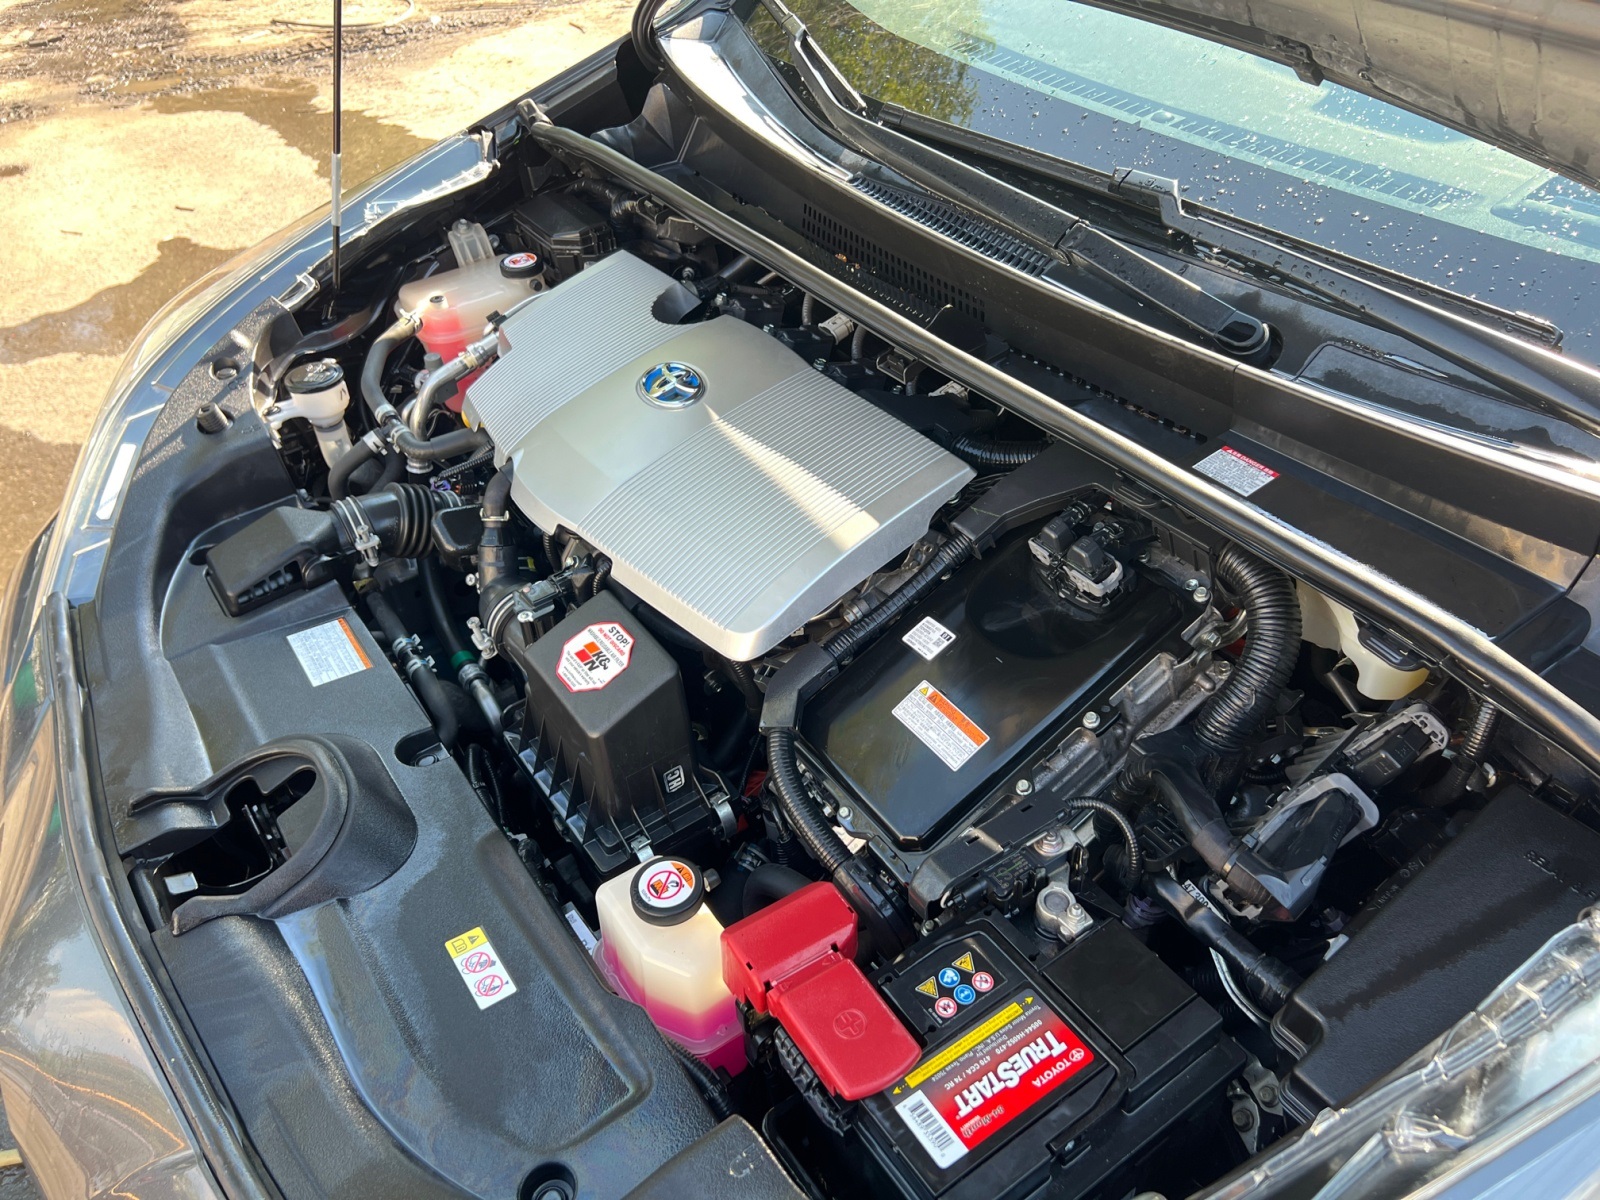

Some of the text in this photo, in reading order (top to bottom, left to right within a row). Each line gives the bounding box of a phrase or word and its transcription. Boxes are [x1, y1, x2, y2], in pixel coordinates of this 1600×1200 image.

[608, 626, 630, 647] STOP!
[602, 632, 611, 641] NOT
[608, 639, 625, 656] DISCARD
[1023, 1003, 1041, 1017] Toyota
[1010, 1013, 1027, 1027] Motor
[998, 1022, 1013, 1035] Sales
[981, 1033, 1008, 1054] Distributed
[944, 1059, 960, 1072] Texas
[978, 1054, 992, 1066] 470
[965, 1062, 981, 1075] CCA
[1030, 1056, 1072, 1089] TOYOTA
[943, 1079, 955, 1090] RC
[952, 1074, 963, 1084] 74
